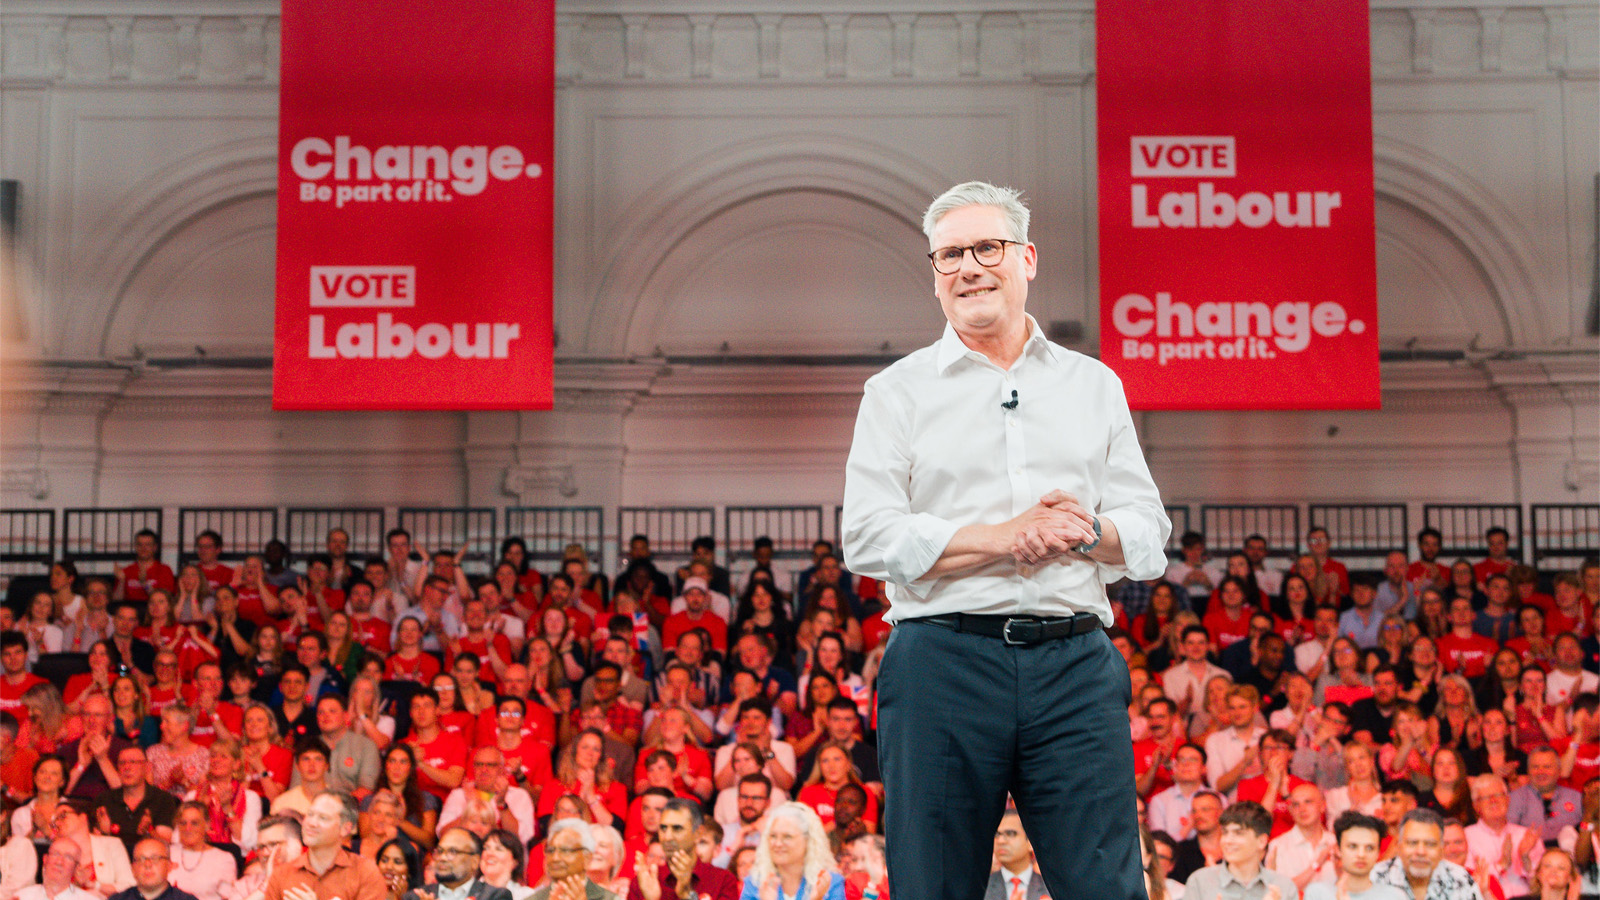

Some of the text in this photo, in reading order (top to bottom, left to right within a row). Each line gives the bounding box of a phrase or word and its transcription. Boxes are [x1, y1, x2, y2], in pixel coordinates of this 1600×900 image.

[291, 136, 542, 195] Change.
[1140, 144, 1228, 168] VOTE
[300, 179, 451, 208] Be part of it.
[1131, 183, 1341, 228] Labour
[319, 274, 407, 299] VOTE
[309, 313, 520, 359] Labour
[1113, 292, 1365, 352] Change.
[1122, 337, 1275, 365] Be part of it.
